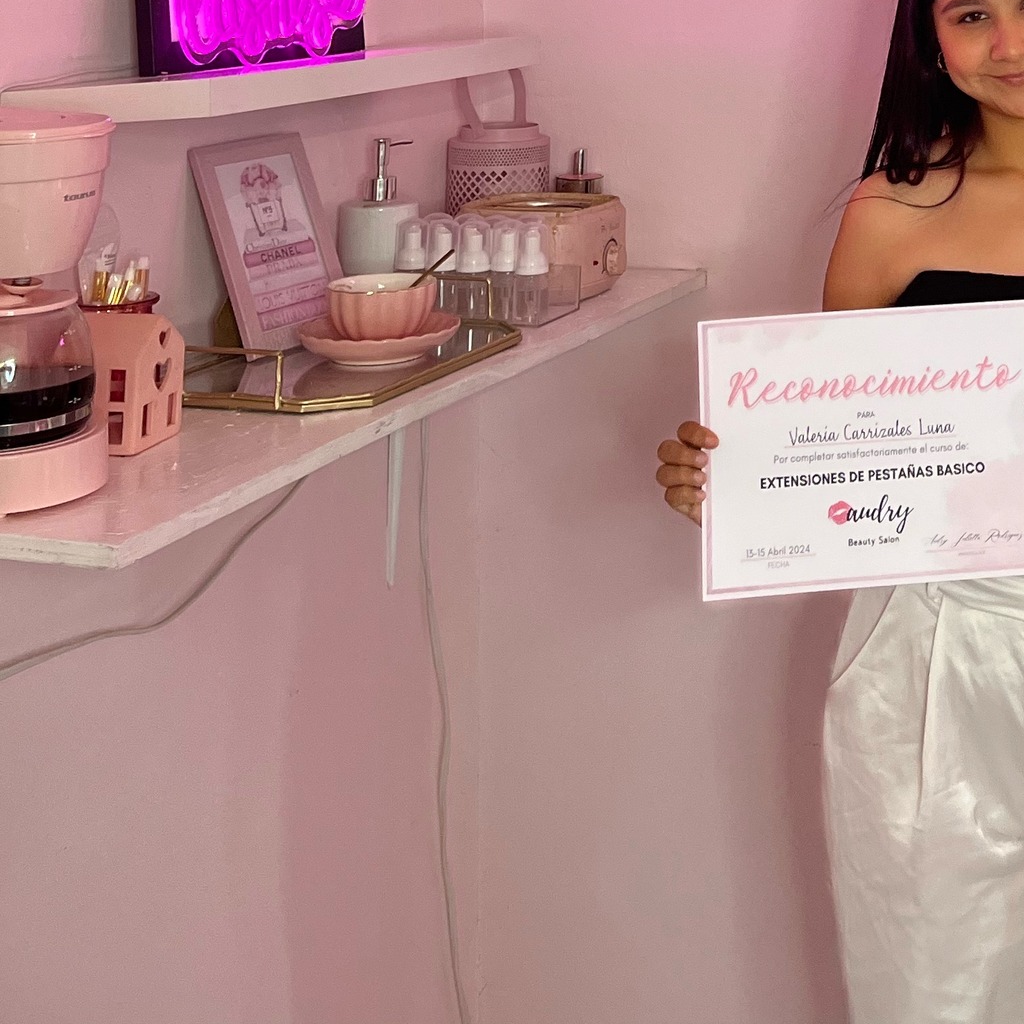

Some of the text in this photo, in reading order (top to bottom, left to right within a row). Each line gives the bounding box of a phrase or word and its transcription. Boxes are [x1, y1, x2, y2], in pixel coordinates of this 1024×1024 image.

[260, 246, 302, 263] CHANEL
[727, 356, 1022, 409] Reconocimiento
[856, 411, 875, 419] PARA
[789, 418, 956, 446] Valeria Carrizales Luna
[773, 455, 788, 464] Por
[790, 452, 834, 464] completar
[919, 443, 928, 453] el
[929, 445, 953, 453] curso
[955, 441, 969, 451] de:
[760, 462, 985, 490] EXTENSIONES DE PESTAÑAS BASICO
[846, 494, 914, 534] audry
[768, 546, 786, 556] Abril
[789, 544, 810, 555] 2024
[848, 536, 900, 547] Beauty Salon
